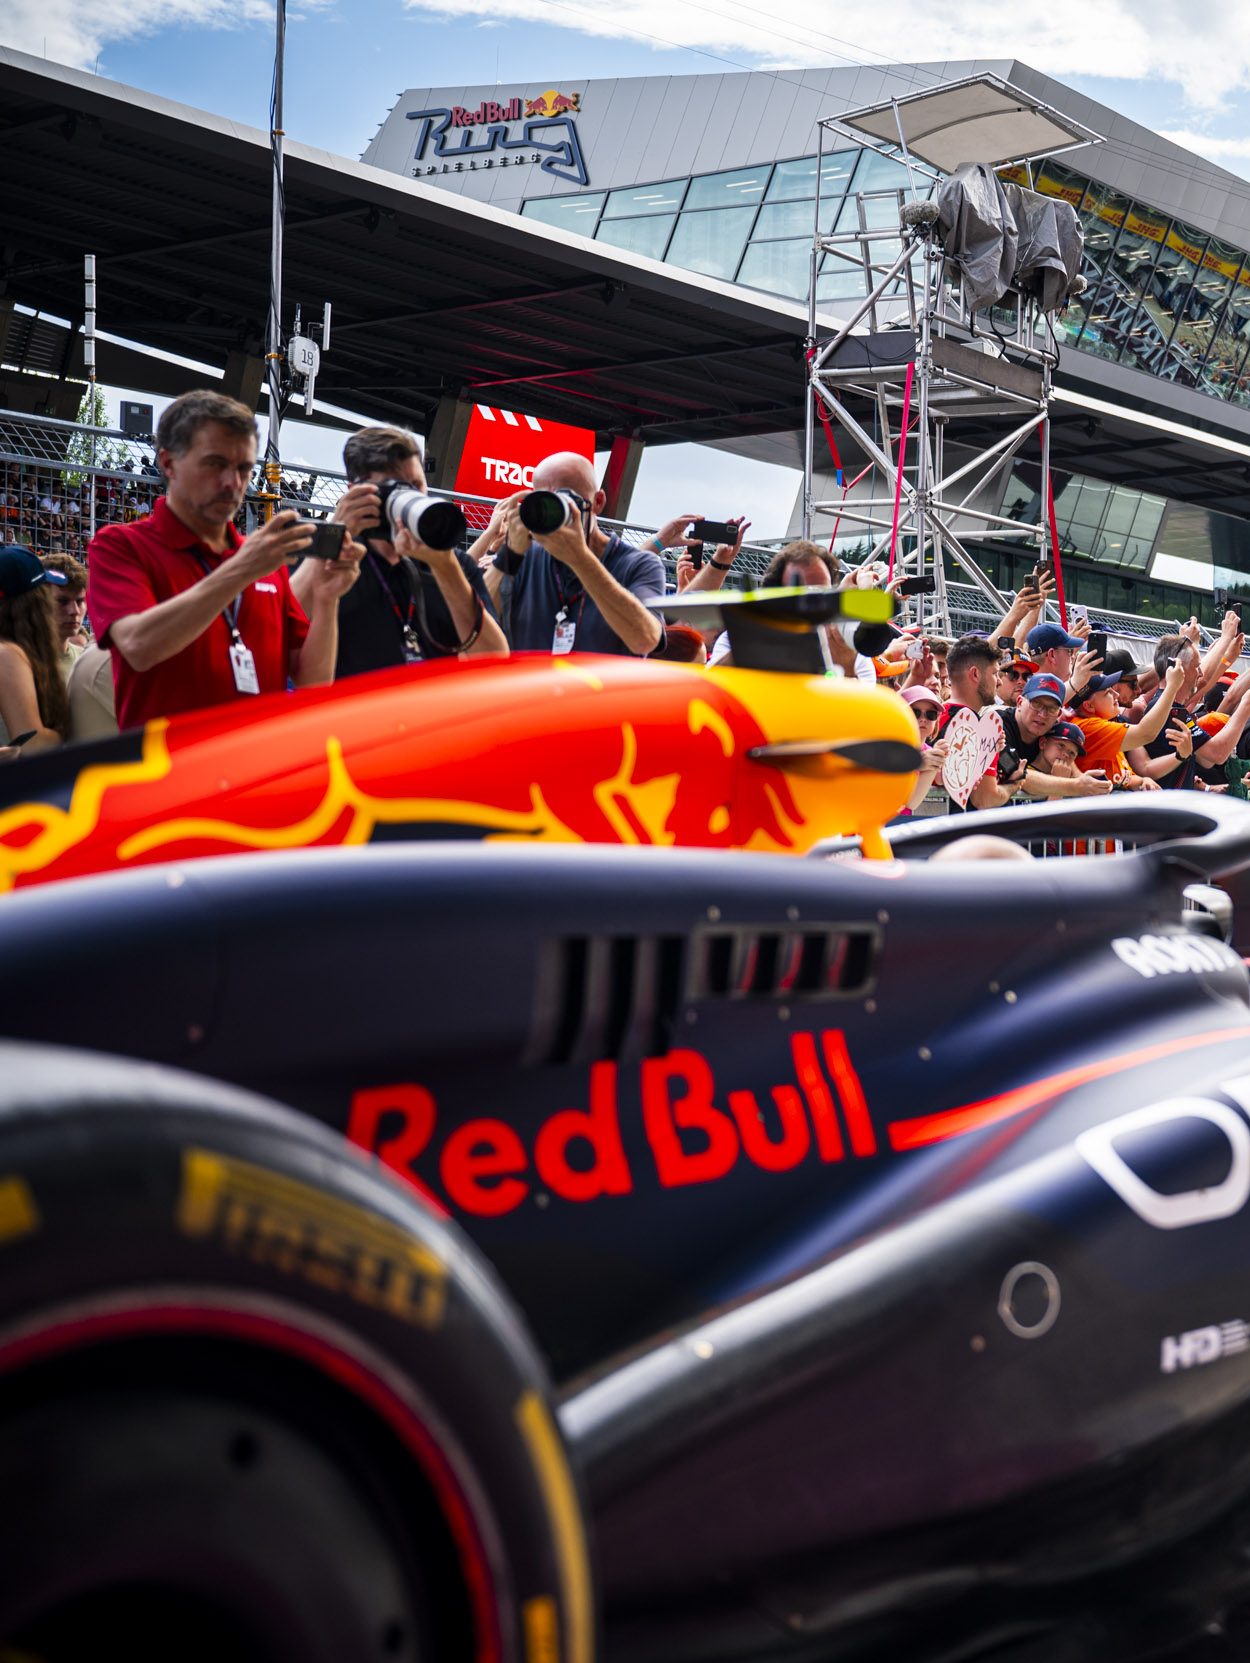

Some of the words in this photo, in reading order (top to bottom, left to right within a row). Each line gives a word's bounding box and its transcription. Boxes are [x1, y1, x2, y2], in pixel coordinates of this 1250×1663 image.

[406, 108, 587, 185] Ring
[411, 153, 540, 176] SPIELBERG
[301, 349, 314, 366] 18
[481, 456, 535, 488] TRAC
[980, 736, 999, 753] MAX
[980, 754, 988, 774] 1
[345, 1060, 633, 1217] Red
[640, 1028, 877, 1188] Bull
